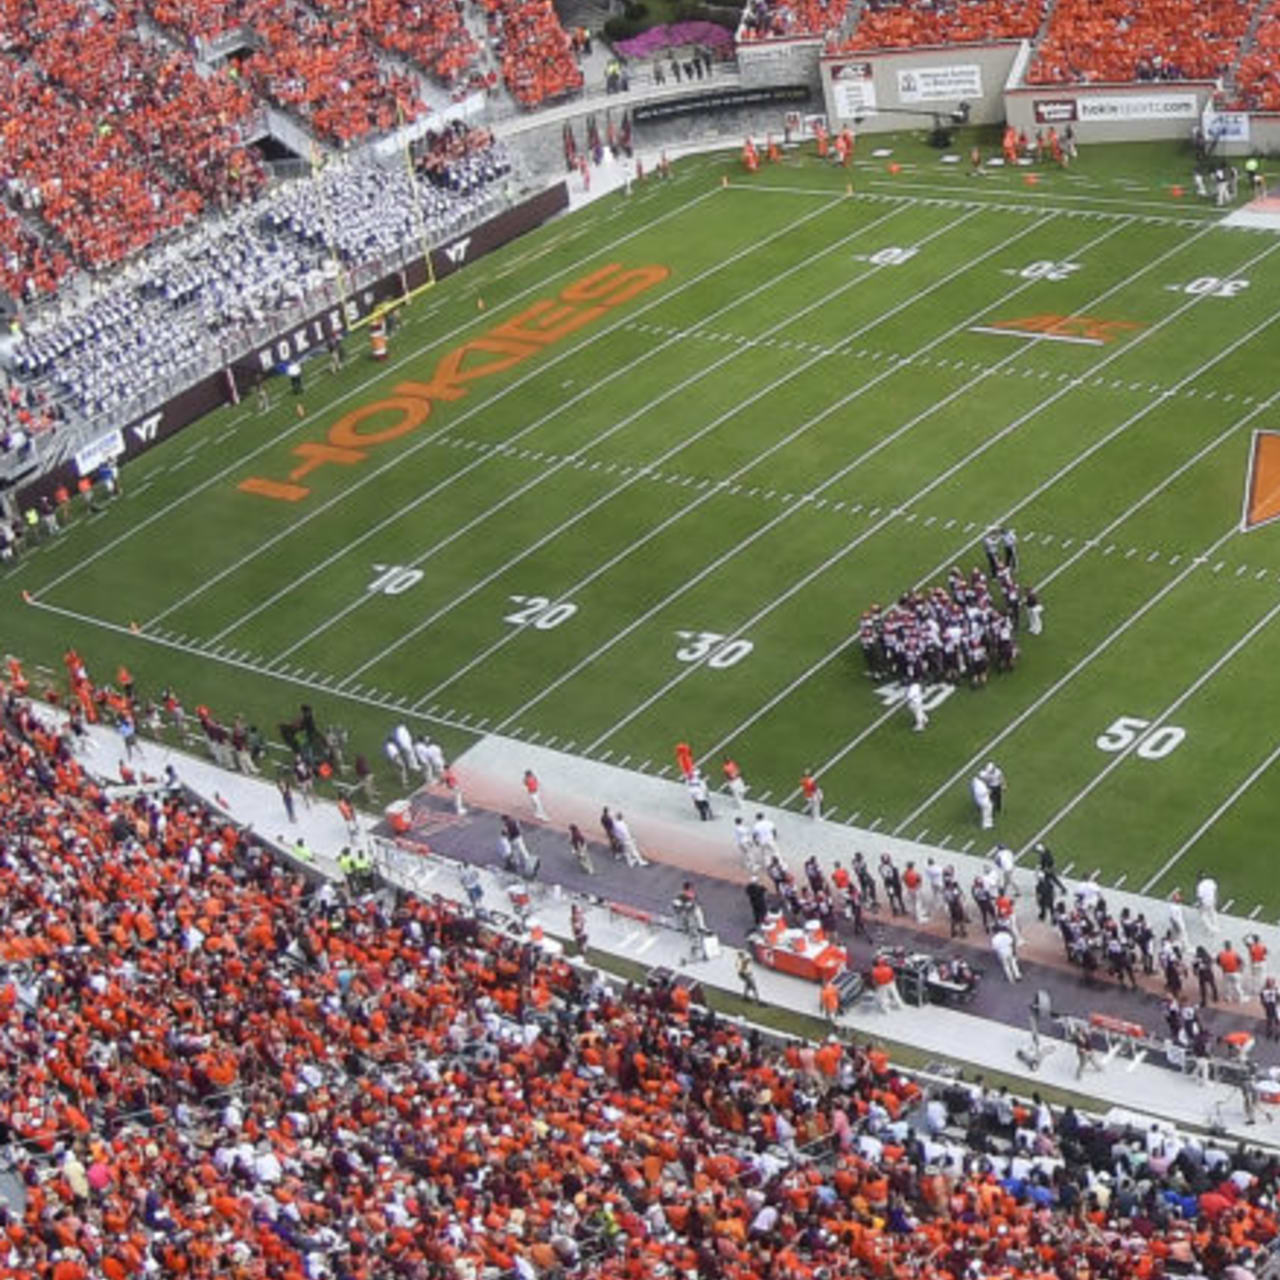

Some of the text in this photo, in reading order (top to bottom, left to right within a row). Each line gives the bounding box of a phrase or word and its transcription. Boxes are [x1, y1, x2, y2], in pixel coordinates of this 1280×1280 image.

[1186, 275, 1251, 297] 30
[237, 262, 671, 502] HOKIES
[367, 566, 425, 595] 10
[504, 598, 577, 630] 20
[675, 632, 754, 668] 30
[1095, 717, 1187, 760] 50
